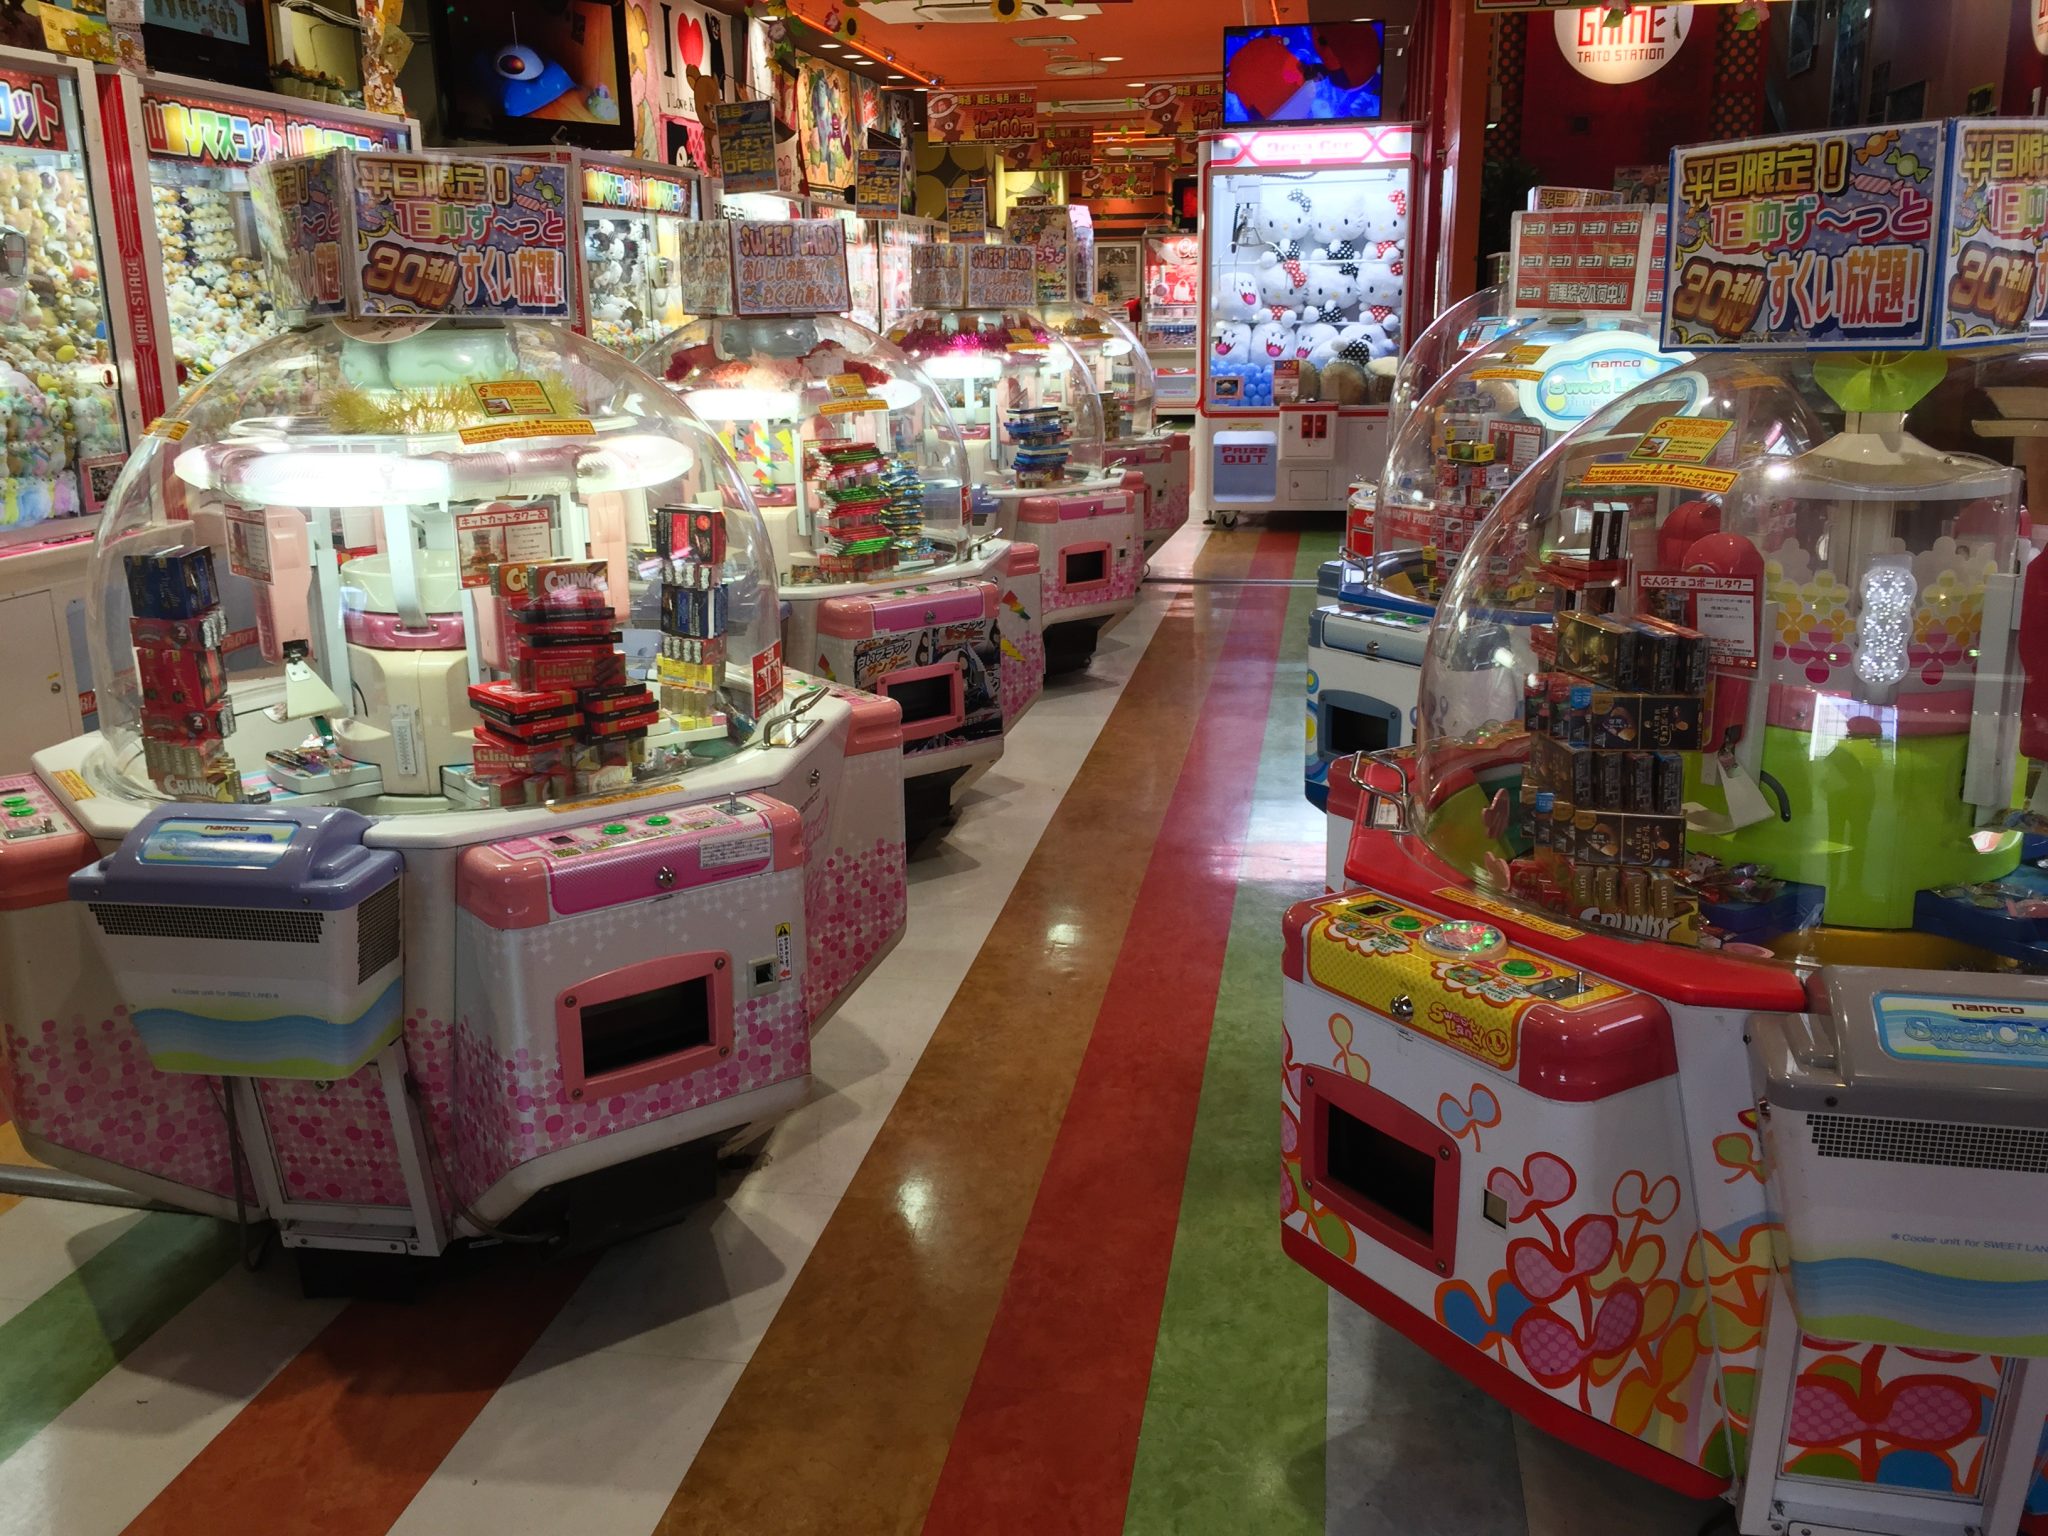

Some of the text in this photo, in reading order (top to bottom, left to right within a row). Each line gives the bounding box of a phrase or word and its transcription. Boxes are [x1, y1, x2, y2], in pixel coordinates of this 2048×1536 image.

[660, 2, 675, 78] I
[1577, 48, 1664, 63] TAITO STATION
[1964, 133, 2048, 182] 平日限
[723, 158, 774, 173] OPEN
[858, 192, 898, 204] OPEN
[950, 223, 984, 233] OPEN
[741, 225, 794, 257] SWEET
[1591, 359, 1641, 369] namco
[1550, 379, 1611, 395] Sweet
[1221, 446, 1269, 454] PRIZE
[1223, 454, 1266, 464] OUT
[1642, 576, 1752, 590] 大人のチョコボールタワー
[164, 774, 221, 799] CRUNKY
[1952, 1003, 2025, 1015] namco
[1904, 1016, 1994, 1042] Sweet
[1902, 1233, 1937, 1244] Cooler
[1940, 1237, 1960, 1246] unit
[1965, 1239, 1979, 1248] for
[1983, 1240, 2022, 1251] SWEET
